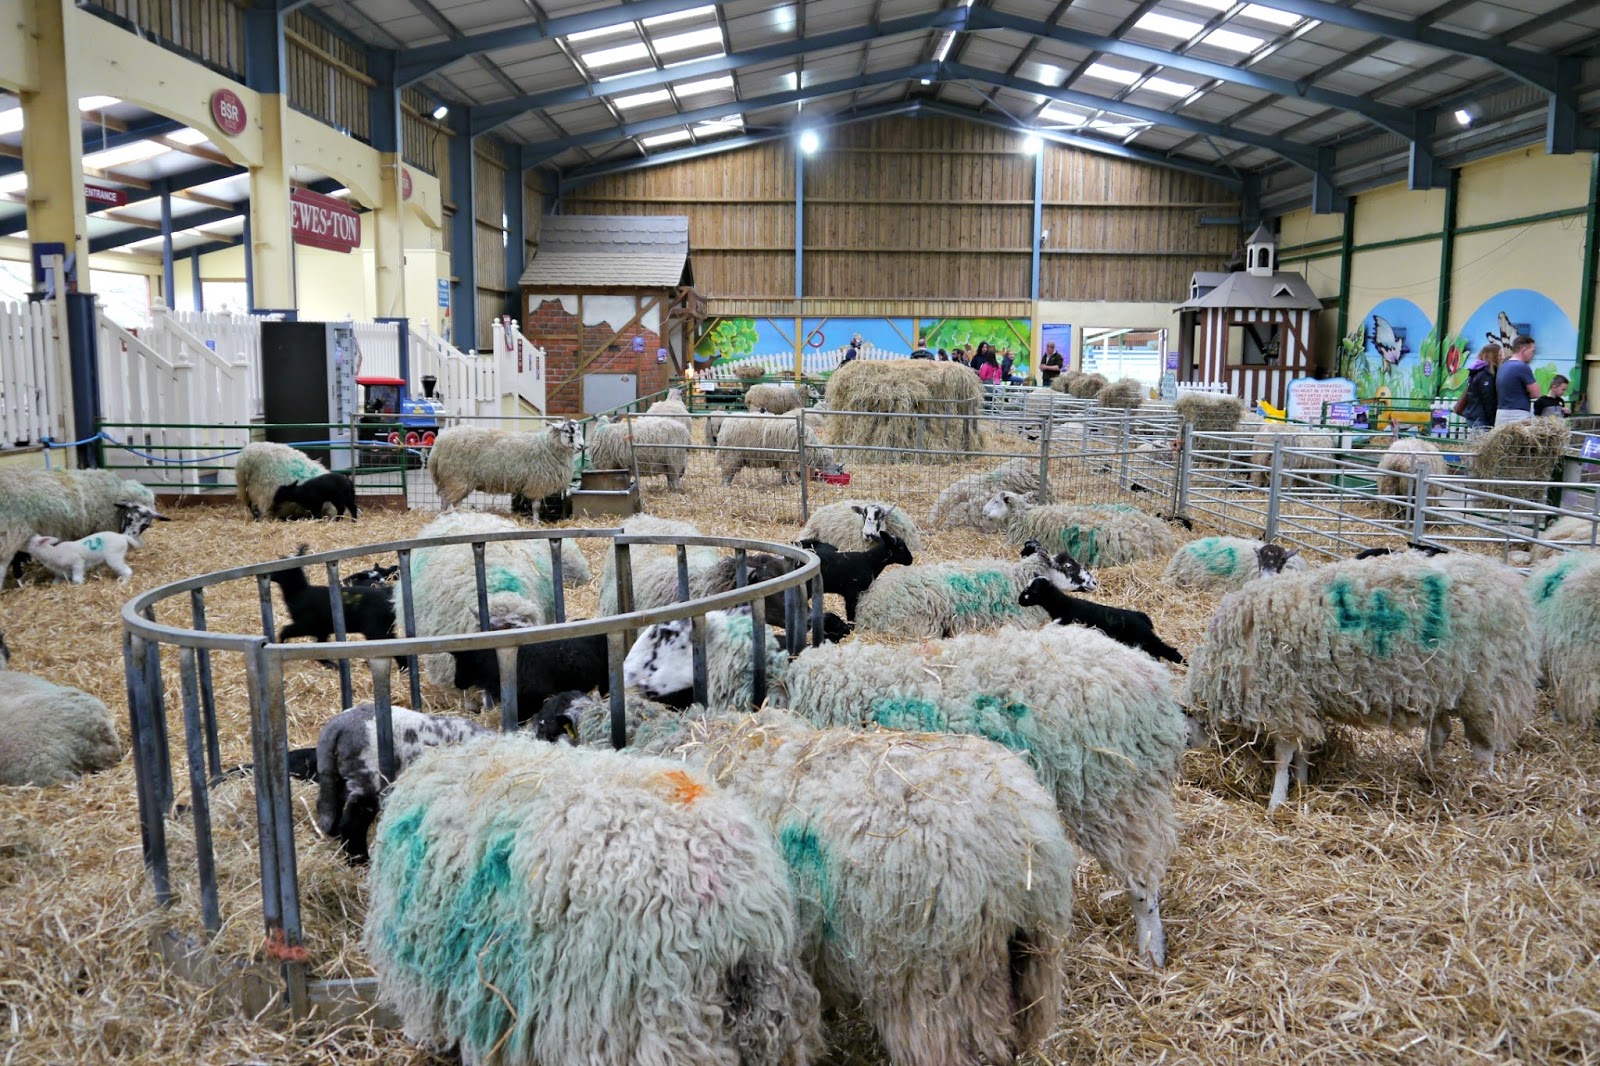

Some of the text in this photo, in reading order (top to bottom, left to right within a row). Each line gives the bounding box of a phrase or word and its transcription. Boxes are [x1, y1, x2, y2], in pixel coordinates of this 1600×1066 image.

[220, 100, 239, 123] BSR
[84, 187, 117, 202] ENTRANCE
[290, 201, 357, 242] EWES-TON
